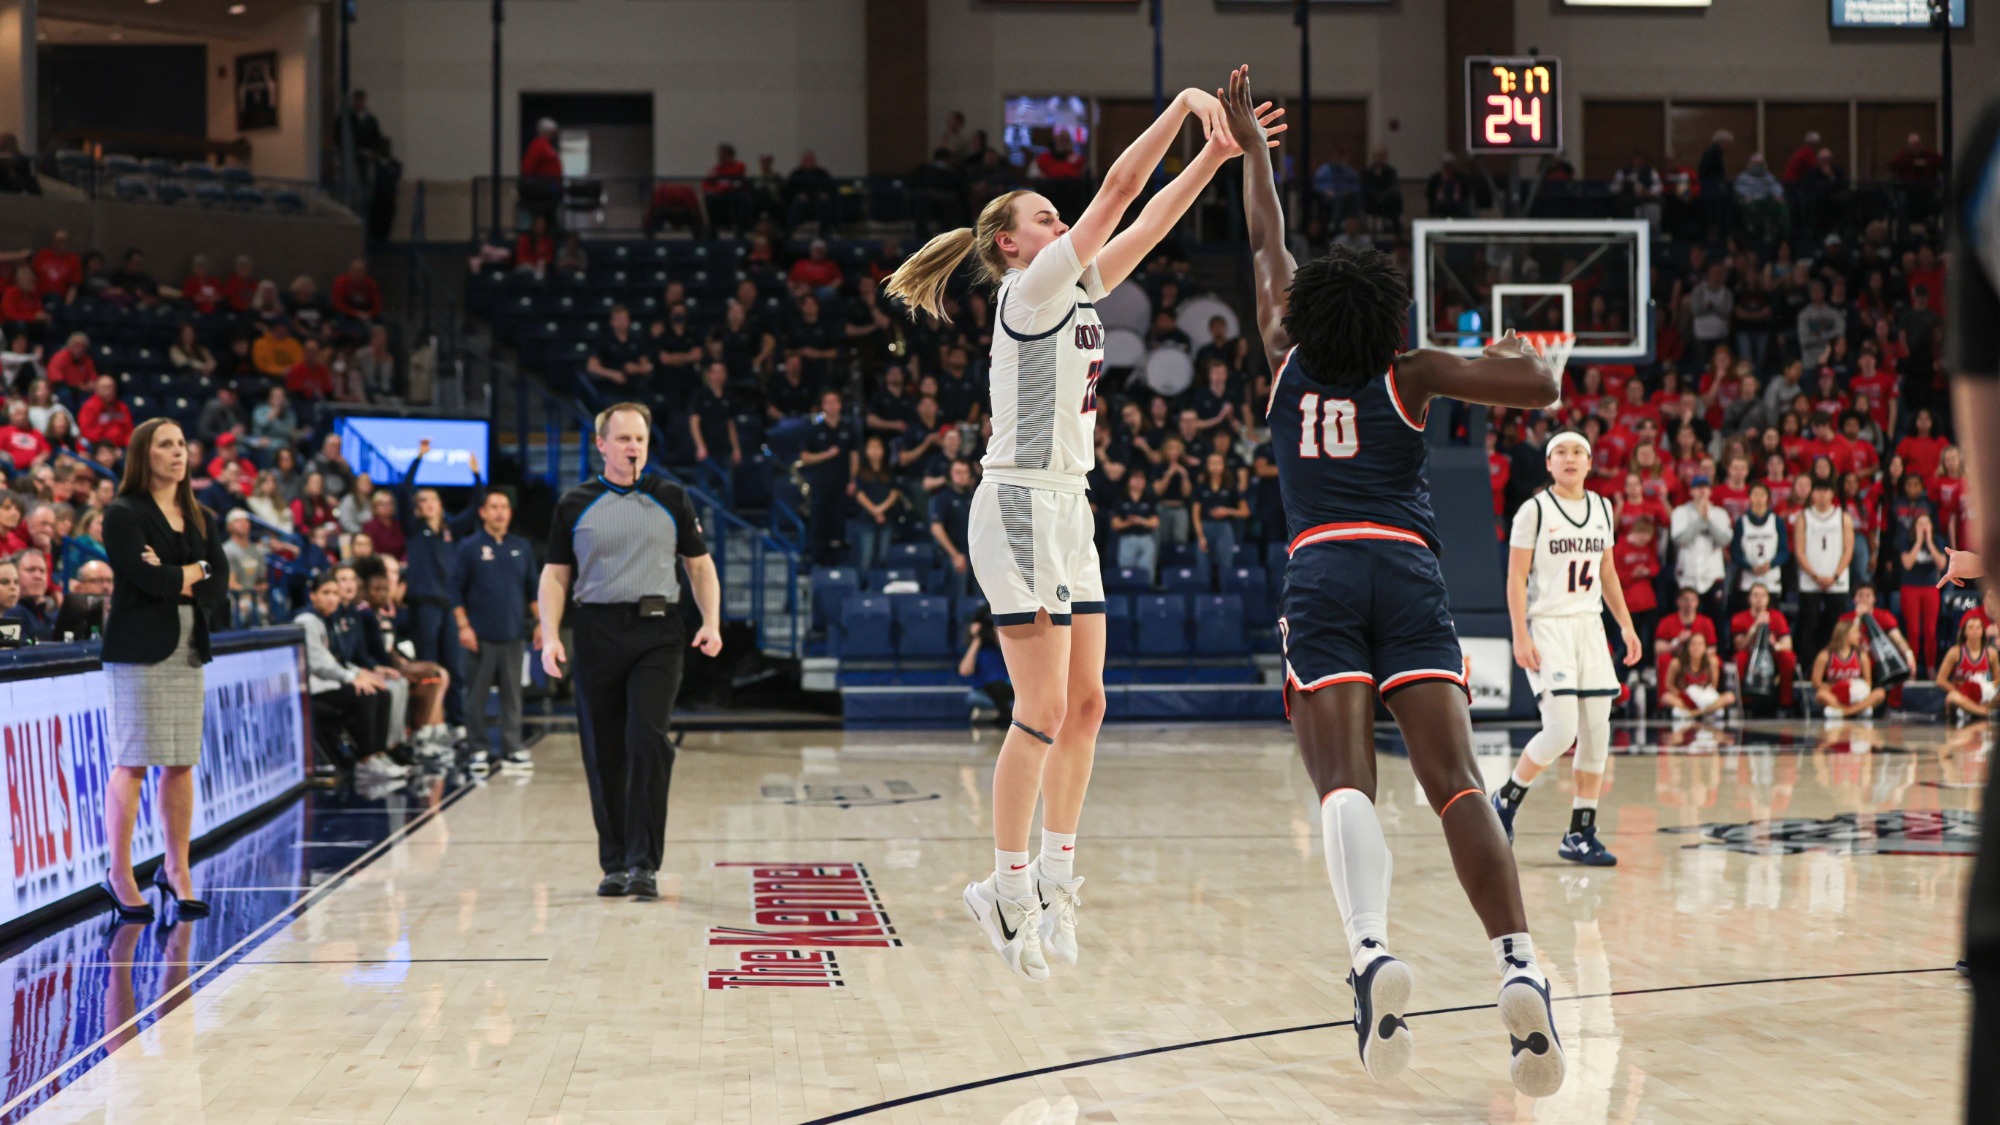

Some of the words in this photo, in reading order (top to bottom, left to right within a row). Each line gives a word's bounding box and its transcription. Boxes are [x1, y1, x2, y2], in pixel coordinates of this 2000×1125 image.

[1493, 66, 1549, 94] 7:17
[1485, 95, 1541, 143] 24
[1299, 391, 1359, 459] 10
[1567, 560, 1594, 593] 14
[3, 713, 73, 880] BILL'S
[704, 861, 903, 948] Kennel
[703, 949, 845, 991] The
